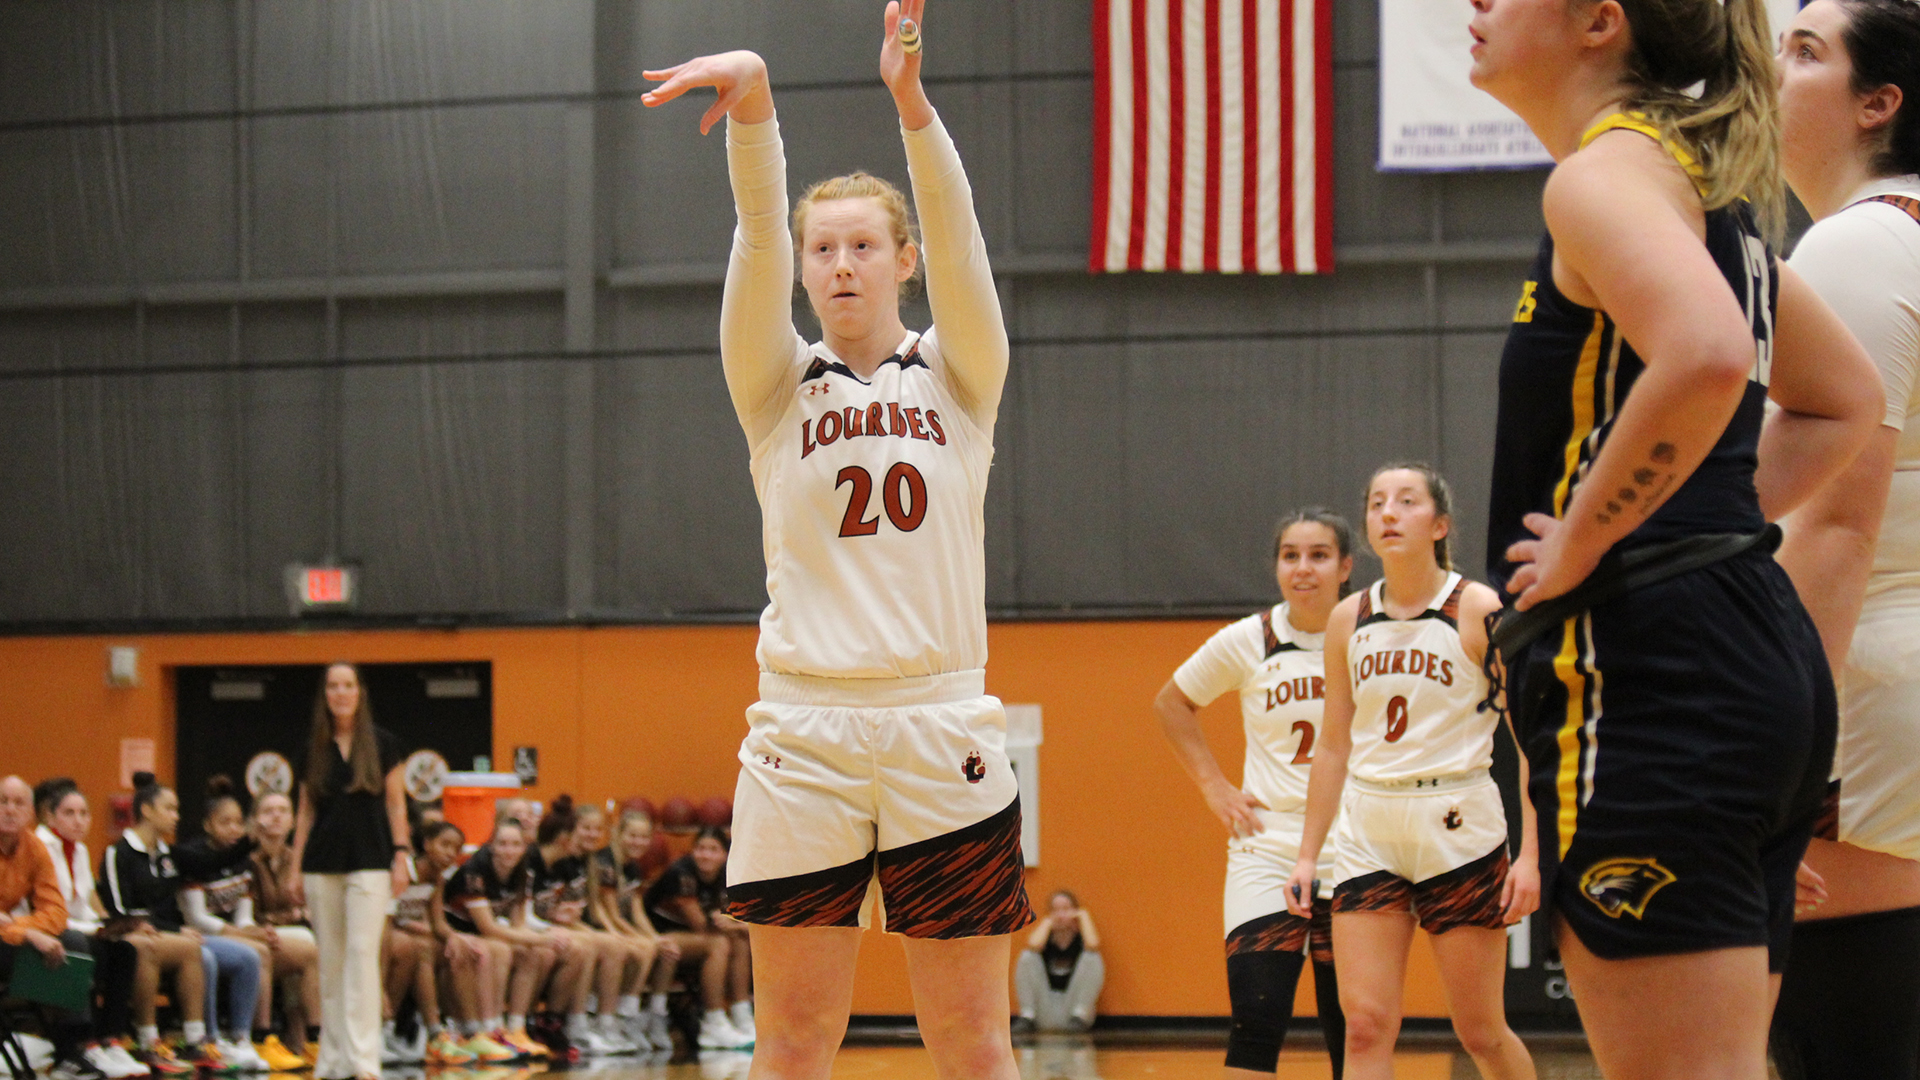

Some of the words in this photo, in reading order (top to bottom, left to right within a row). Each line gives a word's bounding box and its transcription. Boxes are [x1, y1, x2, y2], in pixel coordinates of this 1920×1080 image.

[1467, 120, 1531, 137] ASSOCIATI
[801, 401, 947, 460] LOURDES
[835, 461, 928, 538] 20
[1354, 649, 1454, 688] LOURDES
[1265, 676, 1325, 713] LOUR
[1384, 695, 1408, 743] 0
[1290, 720, 1316, 765] 2
